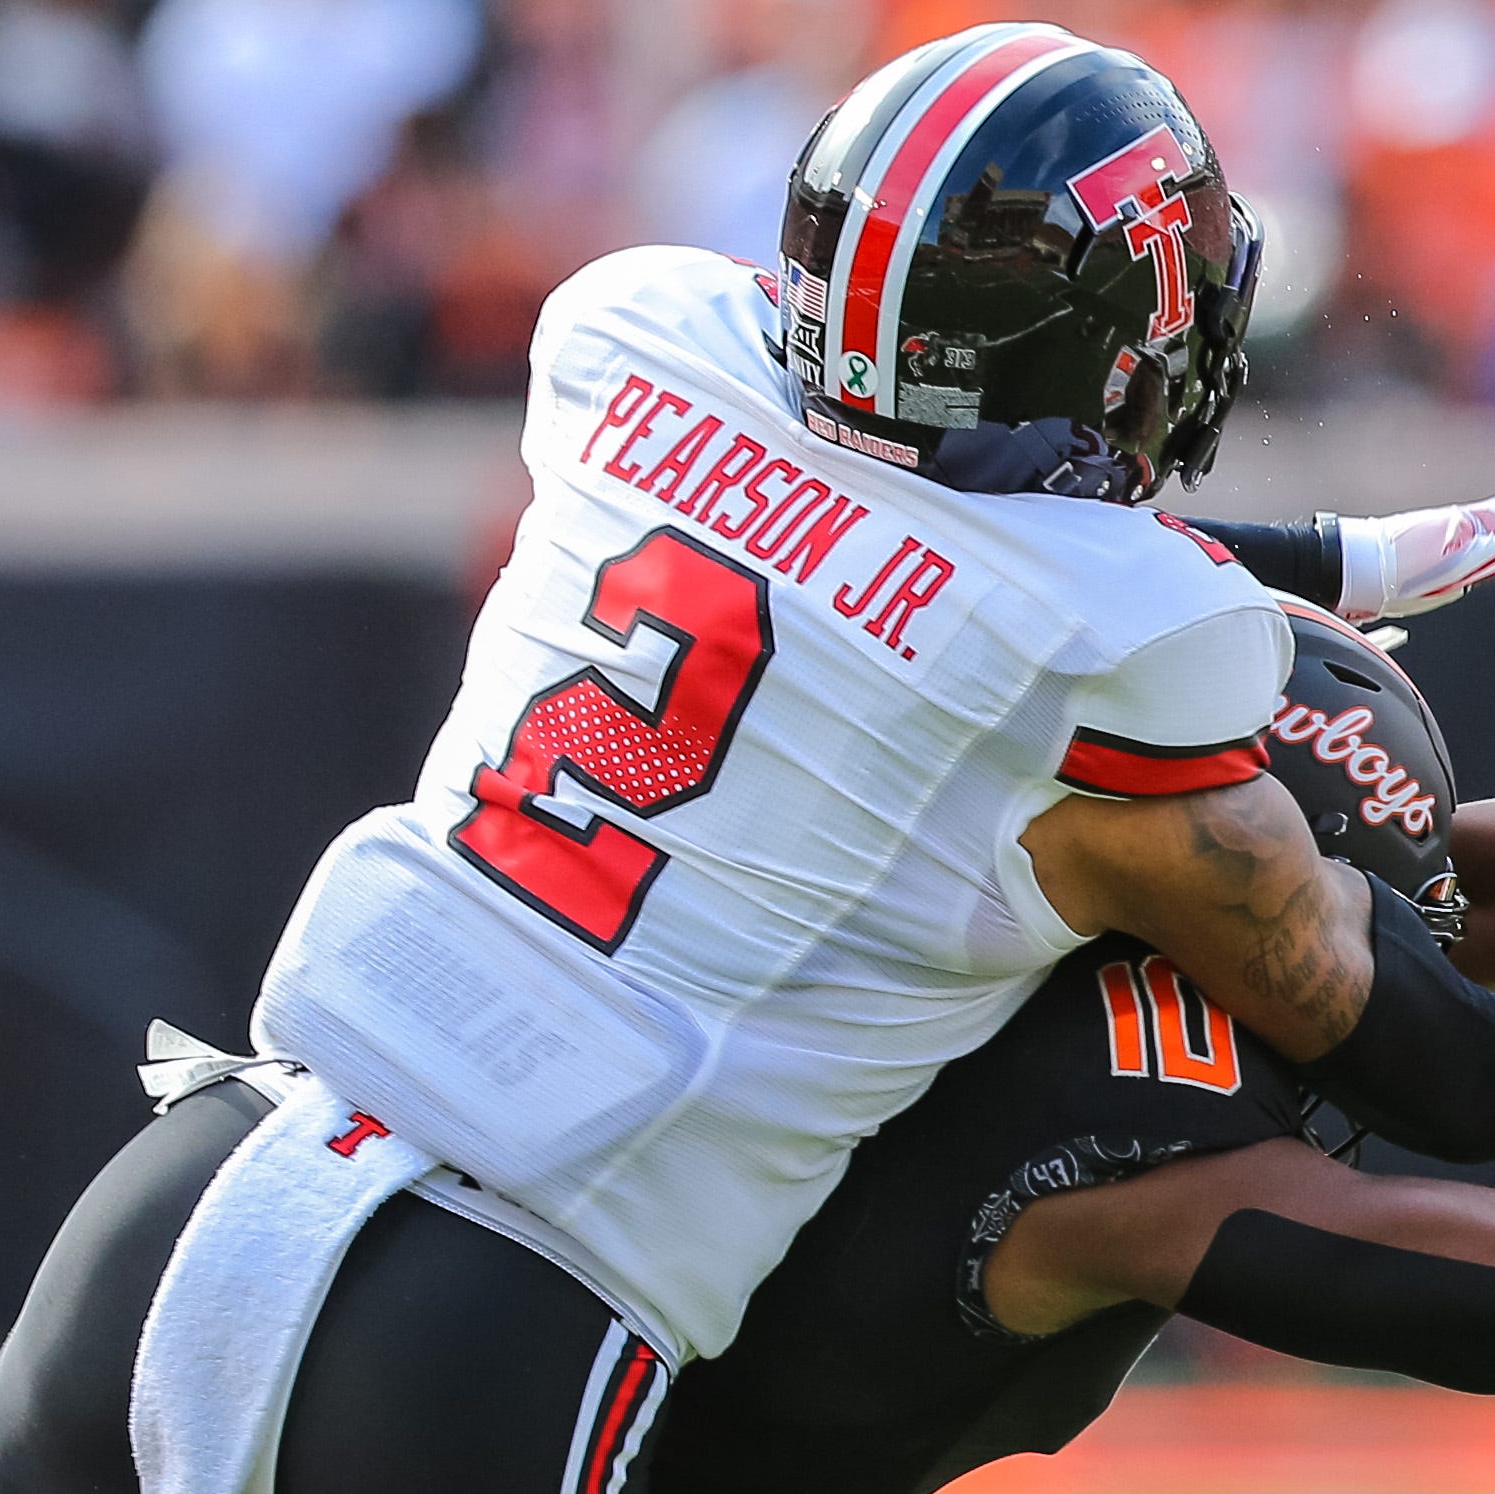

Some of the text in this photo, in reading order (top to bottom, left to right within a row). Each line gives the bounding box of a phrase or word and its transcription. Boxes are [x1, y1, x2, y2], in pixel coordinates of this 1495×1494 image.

[580, 374, 955, 661] PEARSON JR.
[838, 424, 919, 468] RAIDERS
[448, 524, 774, 957] 2
[1270, 692, 1436, 836] wboys
[1096, 953, 1242, 1097] 10
[1032, 1158, 1072, 1188] 43
